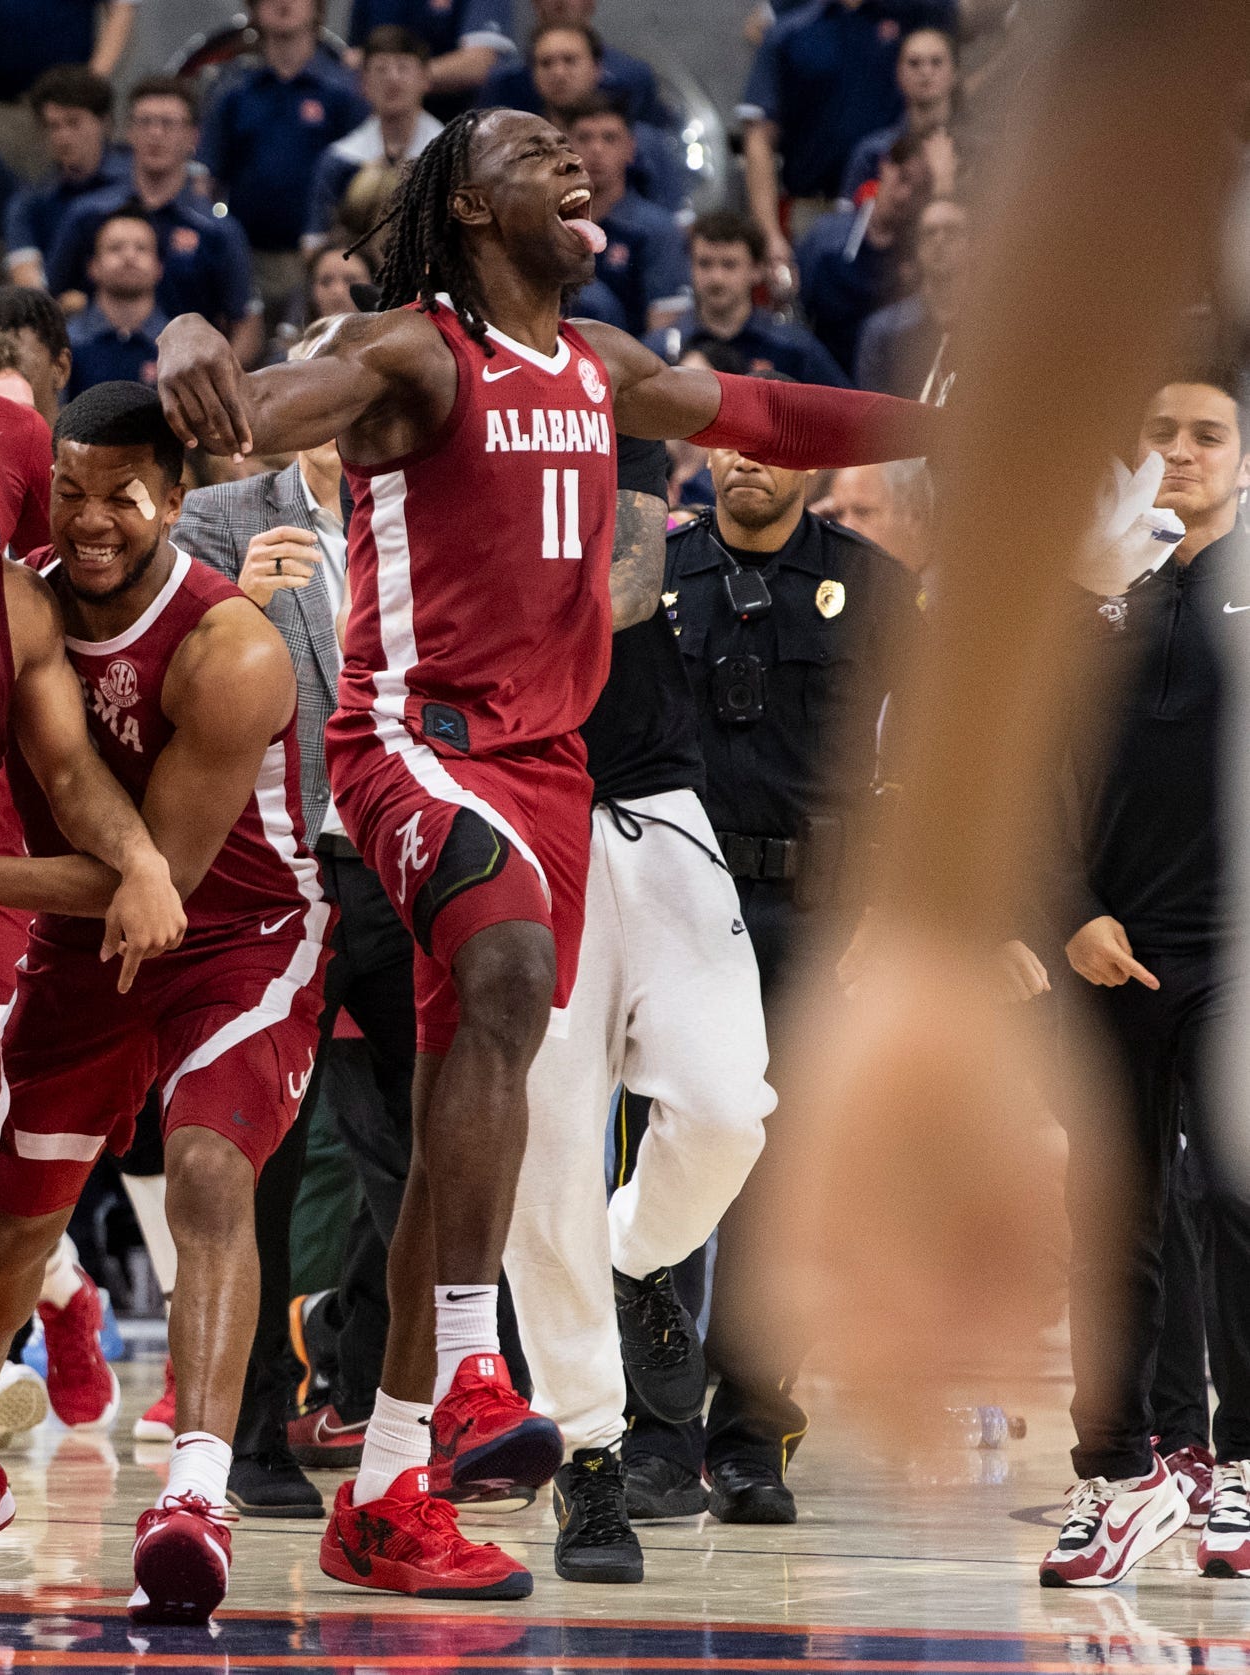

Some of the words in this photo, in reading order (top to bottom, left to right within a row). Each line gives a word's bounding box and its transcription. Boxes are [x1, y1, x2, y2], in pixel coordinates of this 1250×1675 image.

[485, 408, 611, 456] ALABAMA
[542, 468, 583, 559] 11
[110, 663, 135, 697] SEC
